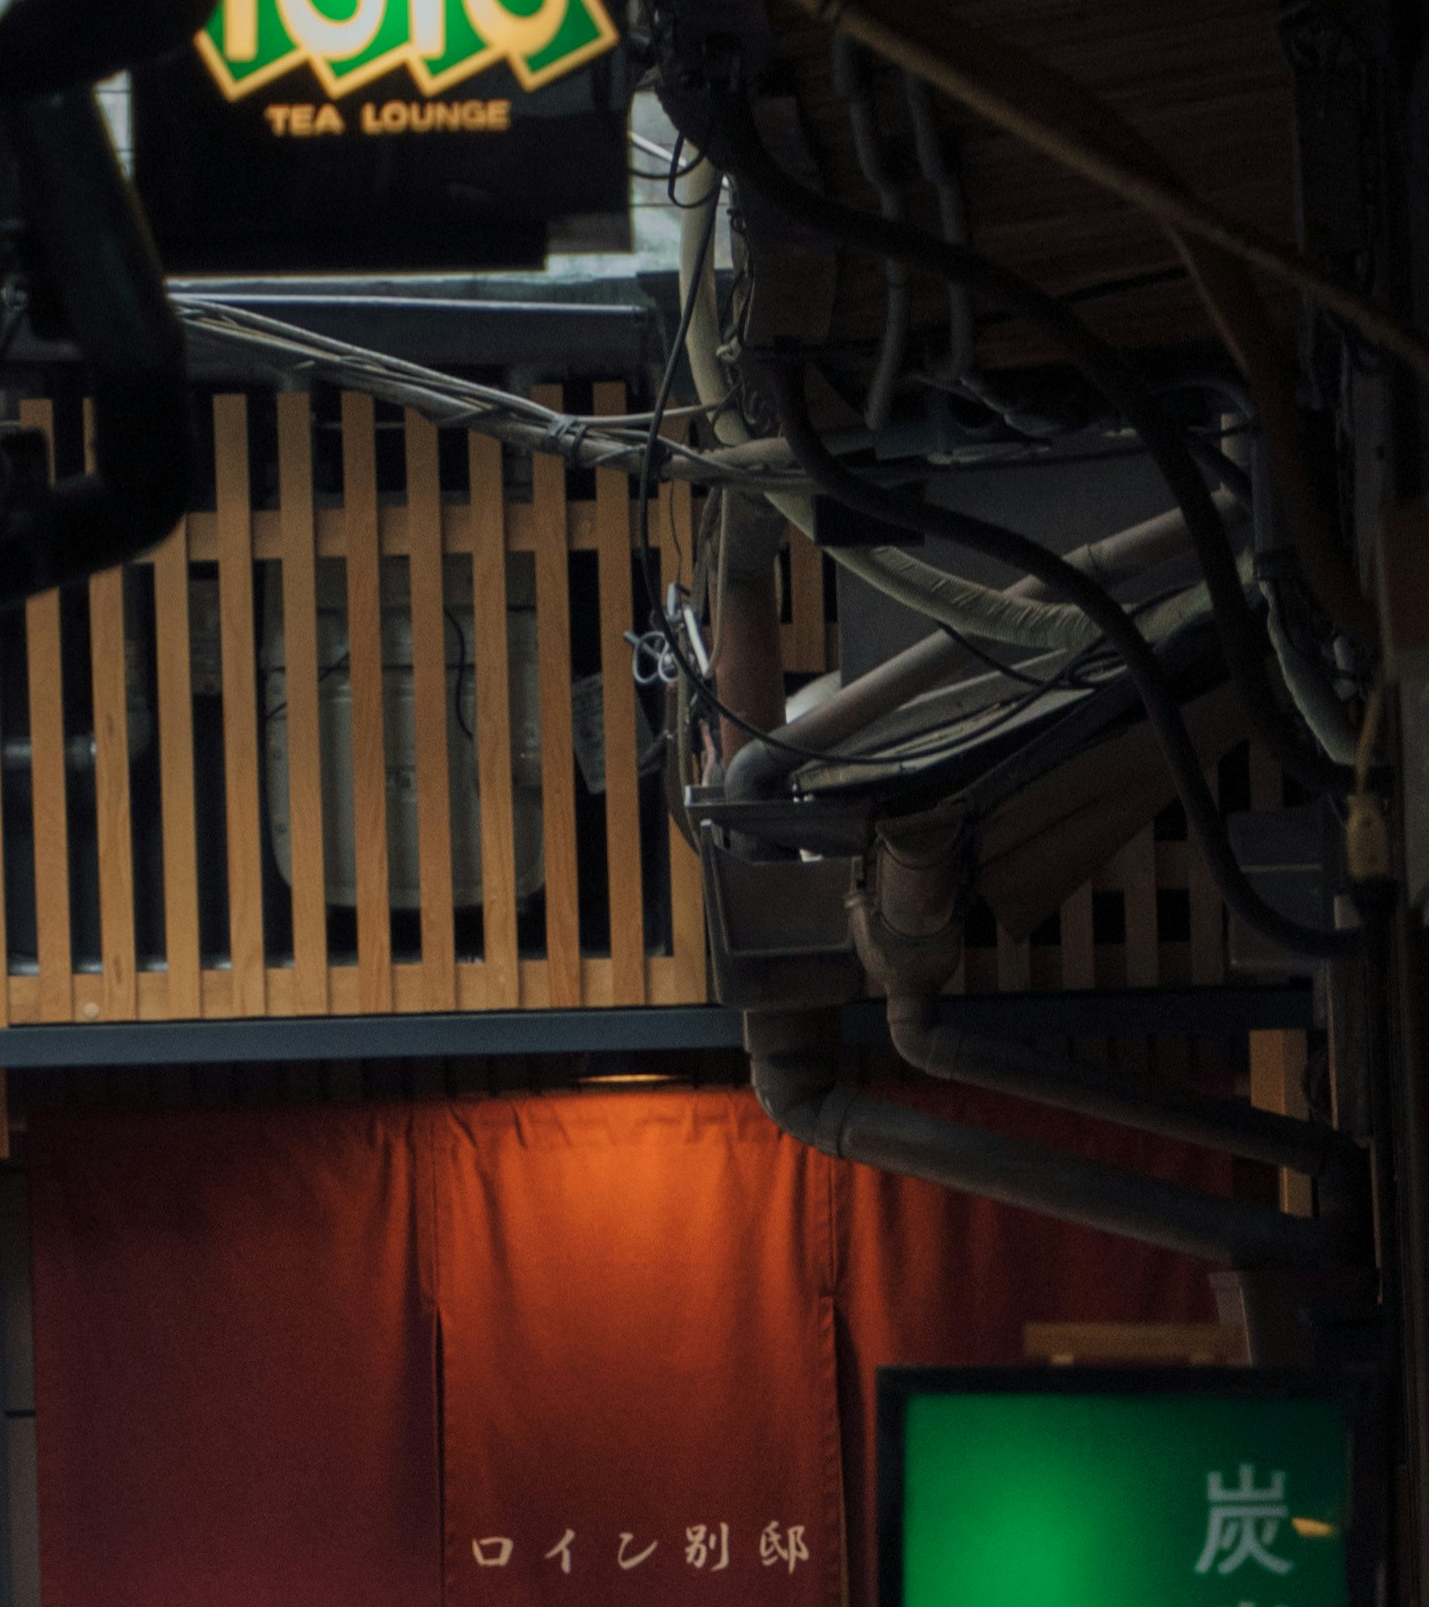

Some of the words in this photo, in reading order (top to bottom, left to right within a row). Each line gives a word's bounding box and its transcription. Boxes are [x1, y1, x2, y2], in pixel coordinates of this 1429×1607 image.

[265, 100, 343, 136] TEA
[362, 97, 512, 135] LOUNGE
[472, 1519, 810, 1574] ロイン別邸
